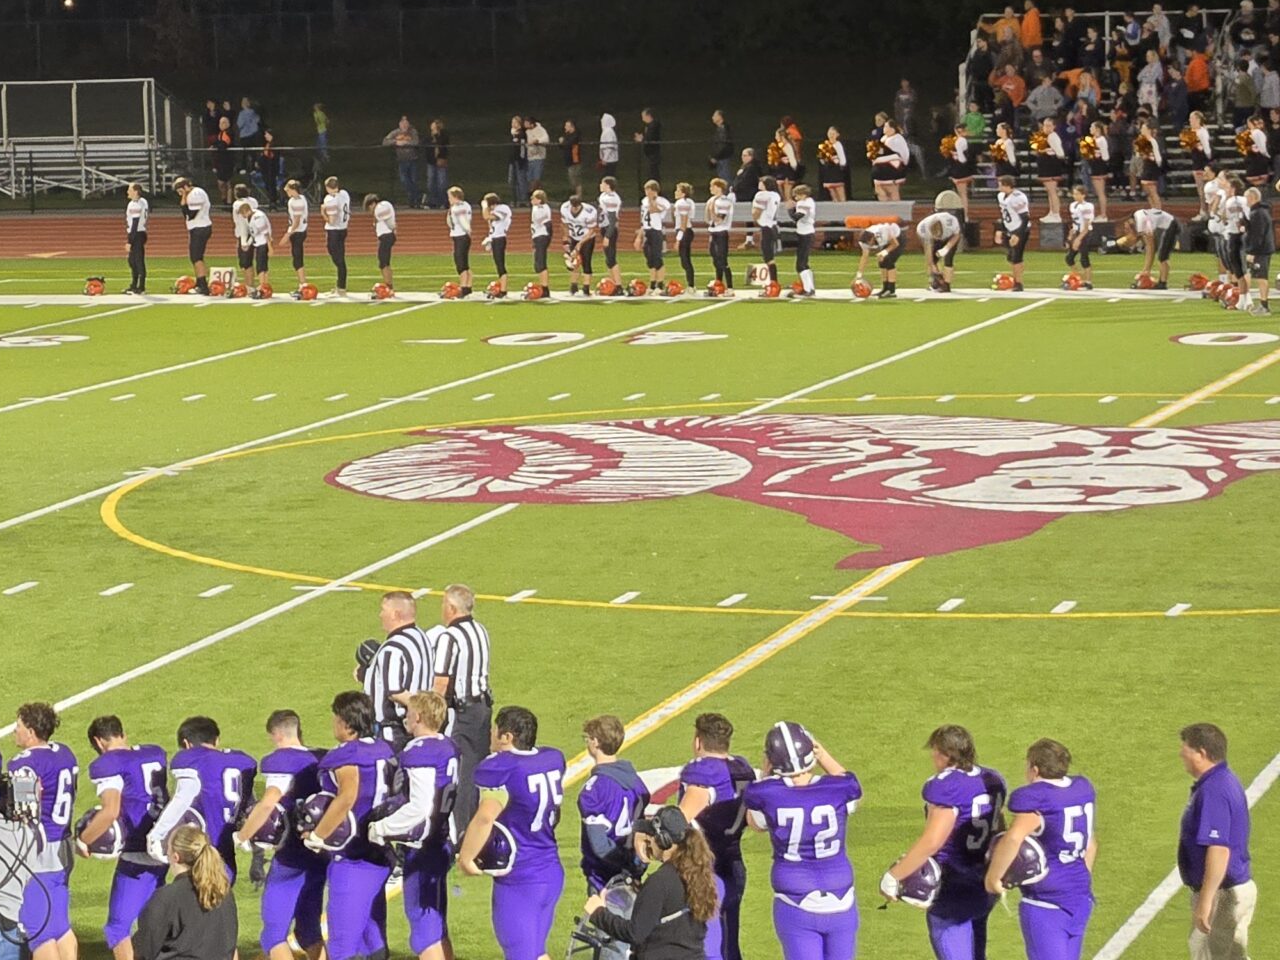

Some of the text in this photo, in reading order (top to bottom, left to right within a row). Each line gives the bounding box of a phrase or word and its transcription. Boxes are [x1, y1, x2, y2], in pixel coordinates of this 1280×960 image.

[750, 267, 769, 281] 40
[527, 769, 563, 833] 75
[777, 804, 841, 861] 72
[1059, 801, 1094, 863] 51
